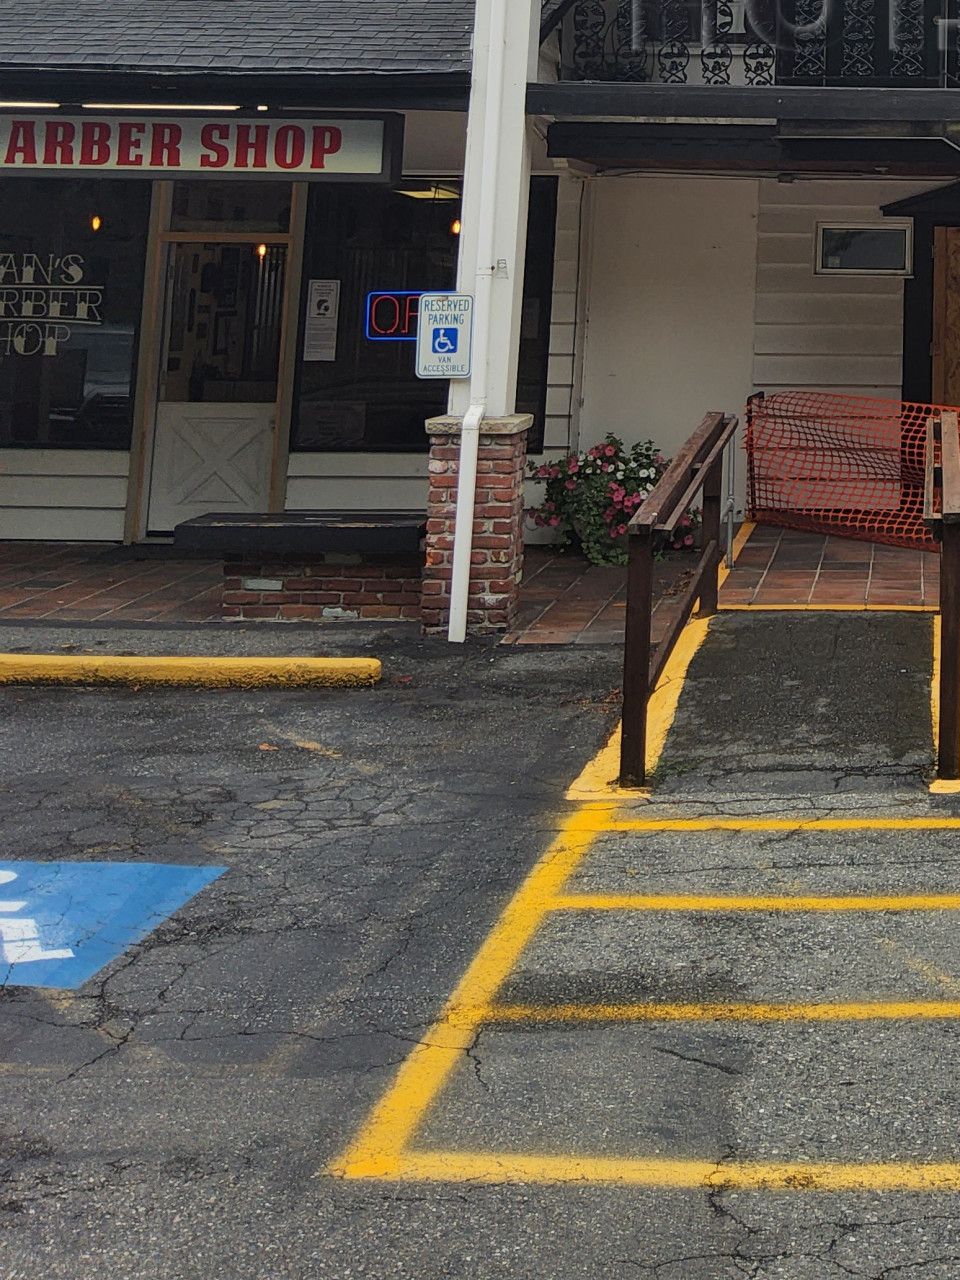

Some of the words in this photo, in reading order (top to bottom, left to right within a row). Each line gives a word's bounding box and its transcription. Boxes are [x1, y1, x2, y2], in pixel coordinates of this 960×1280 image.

[4, 120, 182, 167] ARBER
[200, 124, 342, 169] SHOP
[424, 300, 469, 312] RESERVED
[428, 313, 464, 325] PARKING
